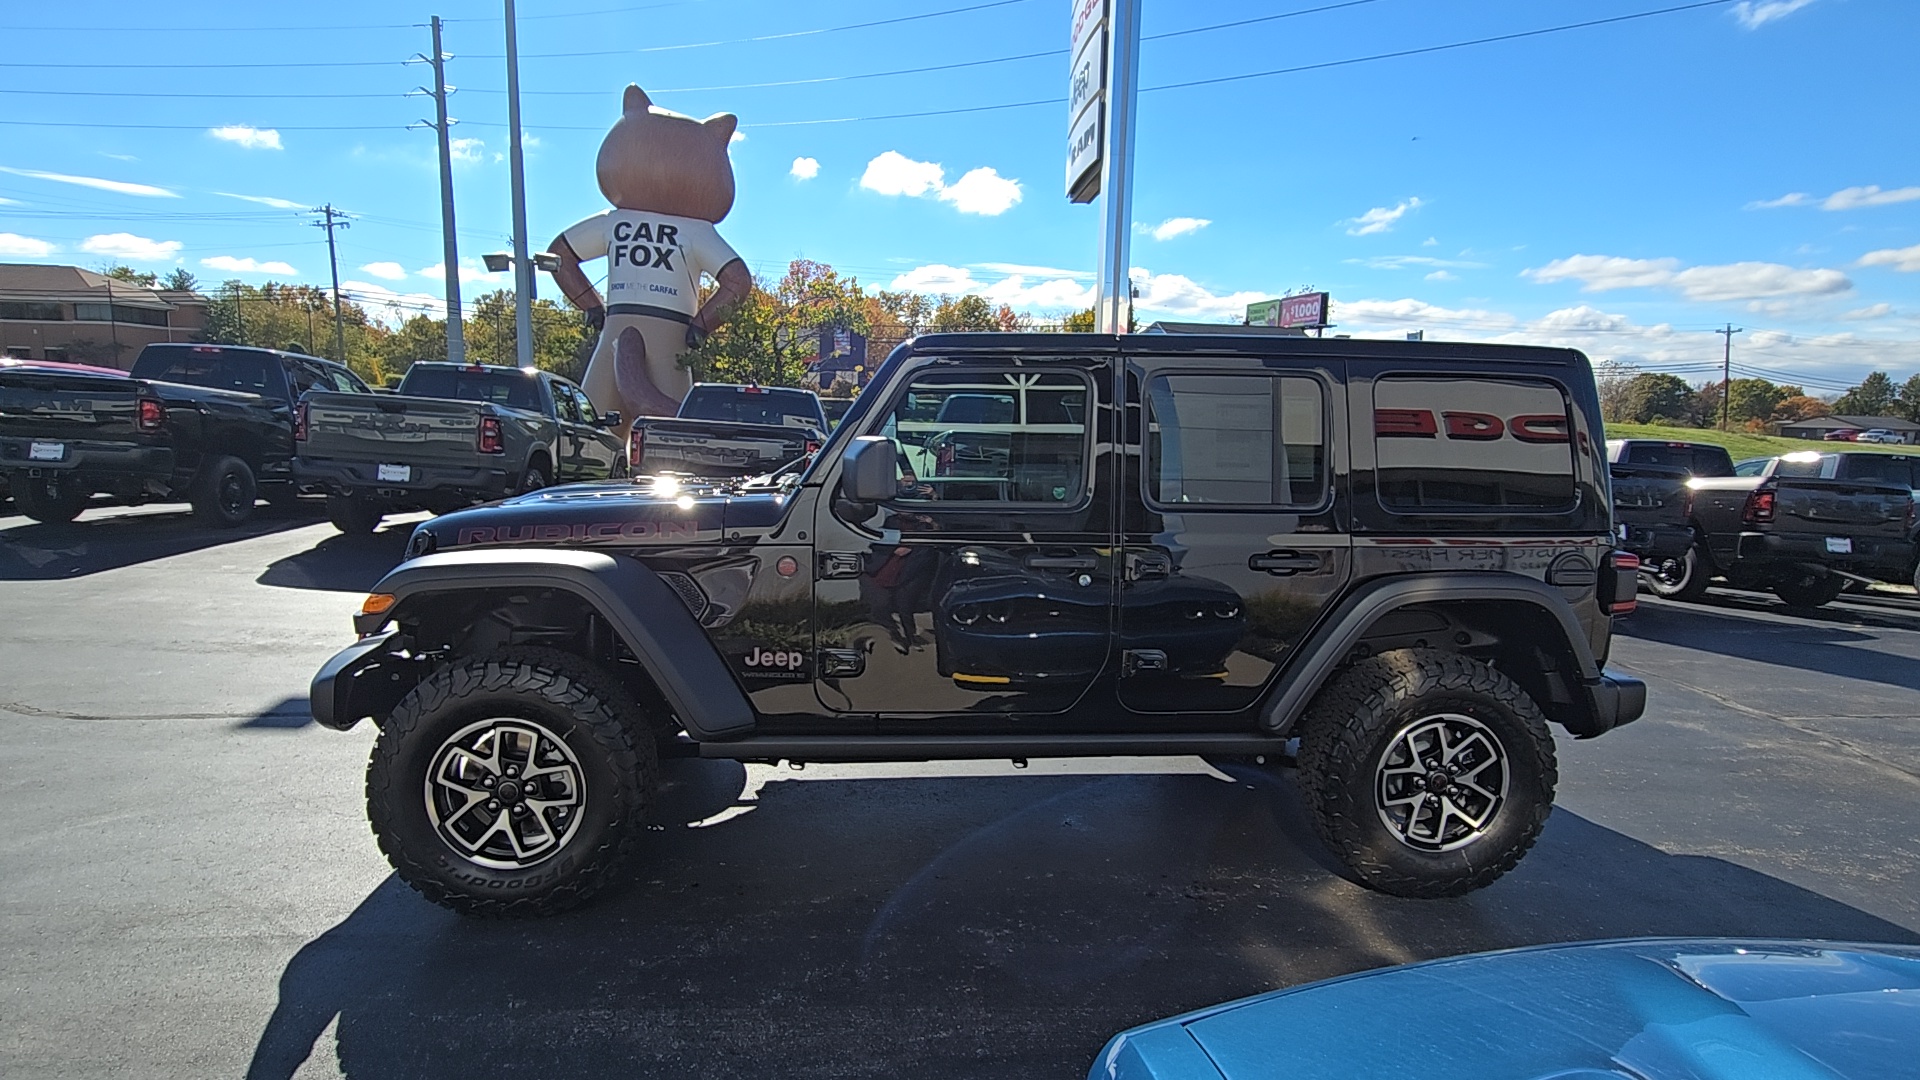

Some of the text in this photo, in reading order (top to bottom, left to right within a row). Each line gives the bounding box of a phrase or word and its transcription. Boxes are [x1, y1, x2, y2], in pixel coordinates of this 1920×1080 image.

[1070, 60, 1091, 113] Jeep
[613, 221, 679, 247] CAR
[614, 244, 675, 273] FOX
[611, 282, 625, 291] SHOW
[649, 283, 678, 296] CARFAX
[456, 520, 699, 545] RUBICON
[744, 646, 803, 671] Jeep
